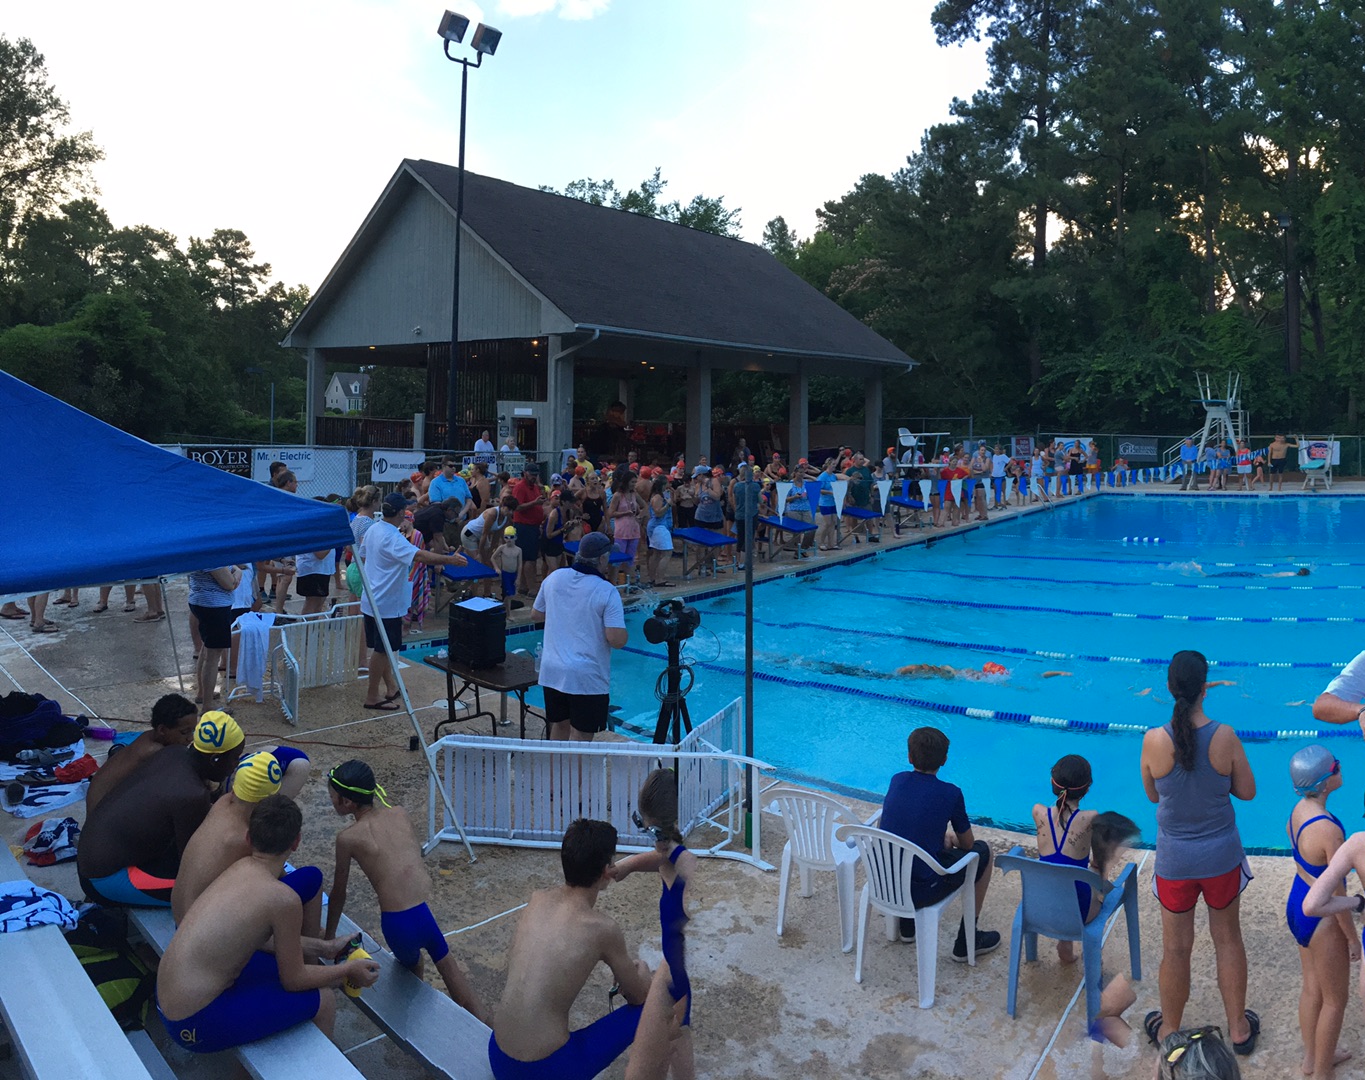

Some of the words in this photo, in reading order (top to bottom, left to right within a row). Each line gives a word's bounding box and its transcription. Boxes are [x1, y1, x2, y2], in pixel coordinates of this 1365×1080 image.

[190, 449, 248, 465] BOYER
[257, 452, 270, 460] Mr.
[280, 451, 311, 461] Electric
